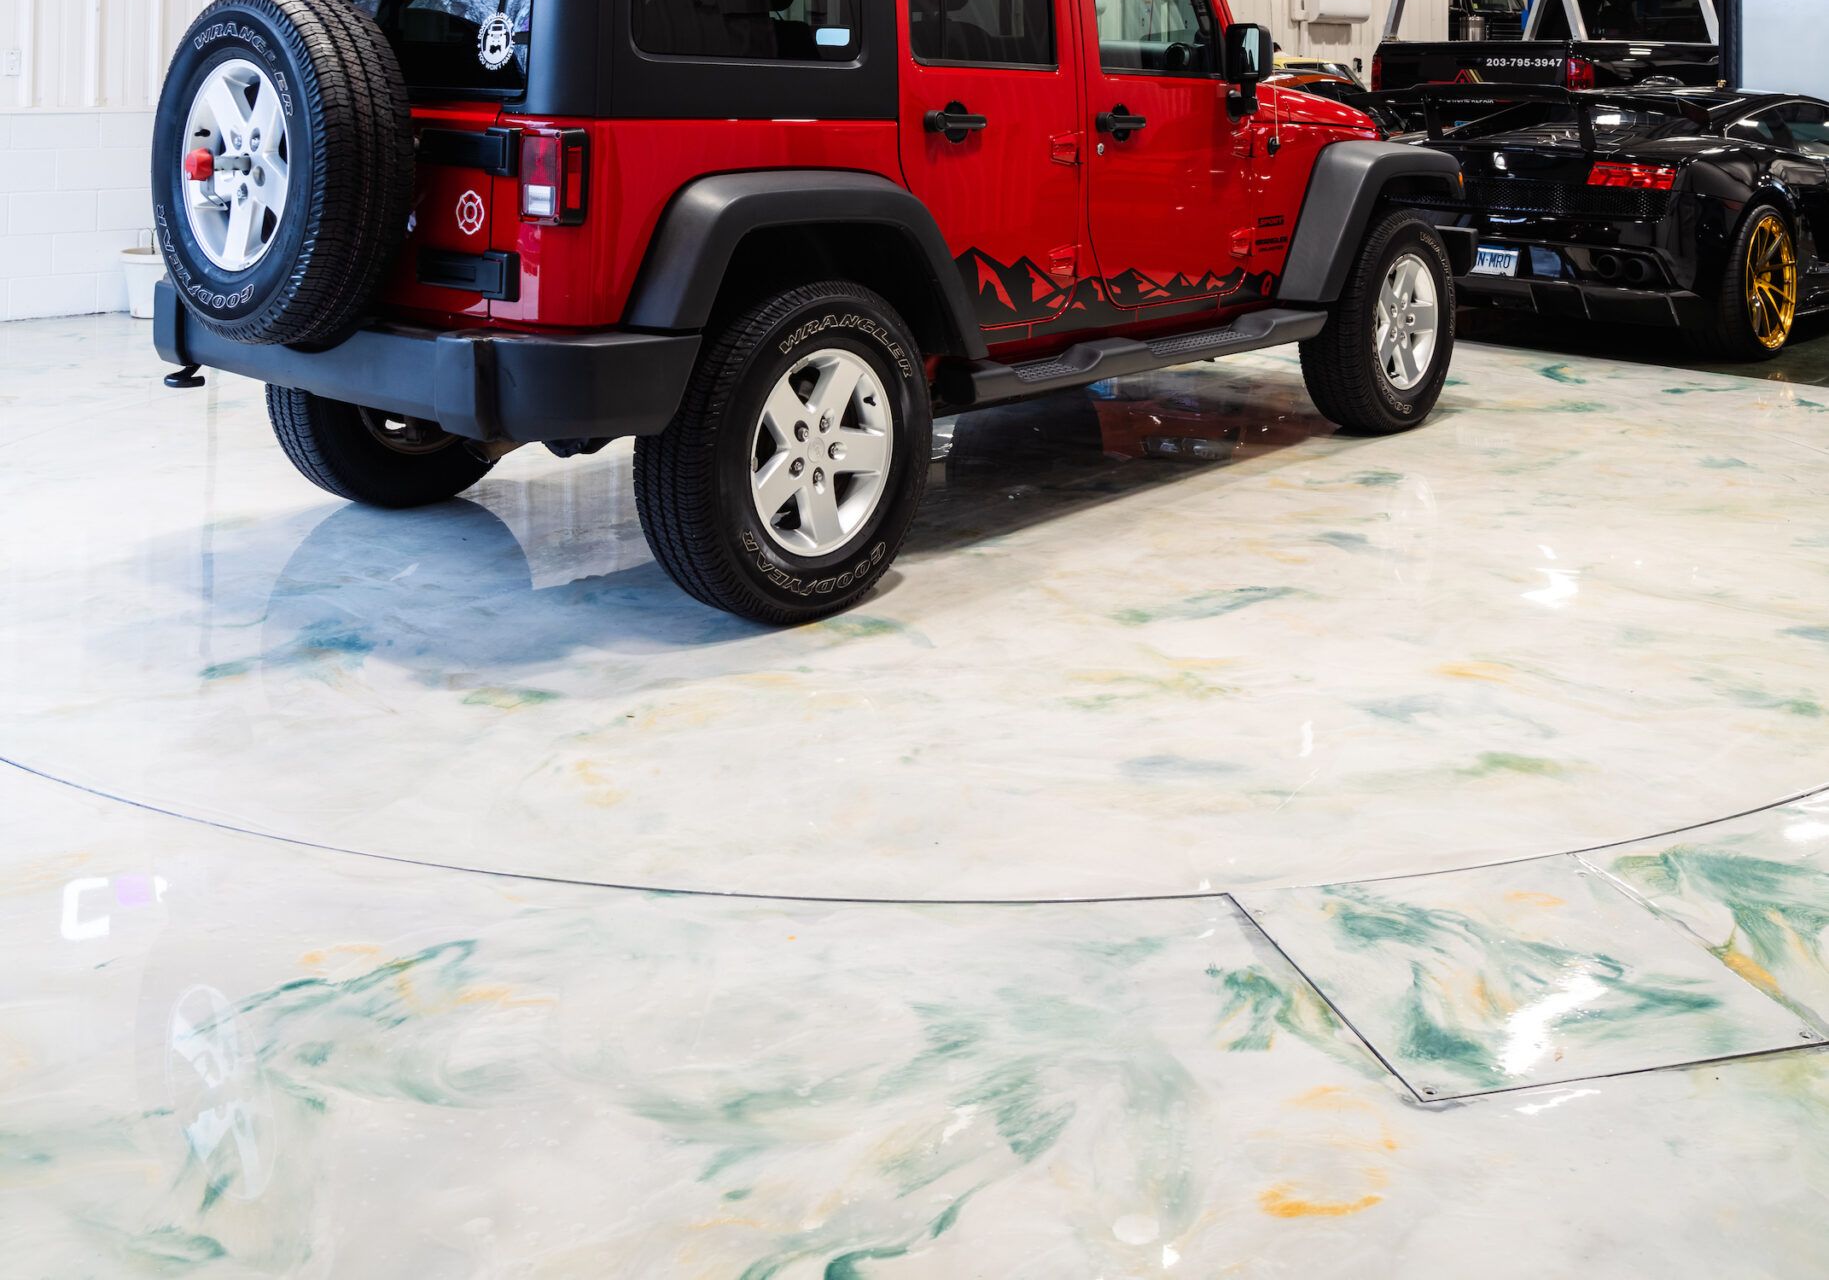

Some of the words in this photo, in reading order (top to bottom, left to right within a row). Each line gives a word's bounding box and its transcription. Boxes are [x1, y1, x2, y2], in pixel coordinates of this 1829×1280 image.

[193, 21, 295, 118] WRANGLER
[1486, 58, 1563, 67] 203-795-3947
[156, 204, 255, 309] GOODYEAR
[779, 313, 914, 379] WRANGLER
[740, 530, 887, 597] GOODYEAR
